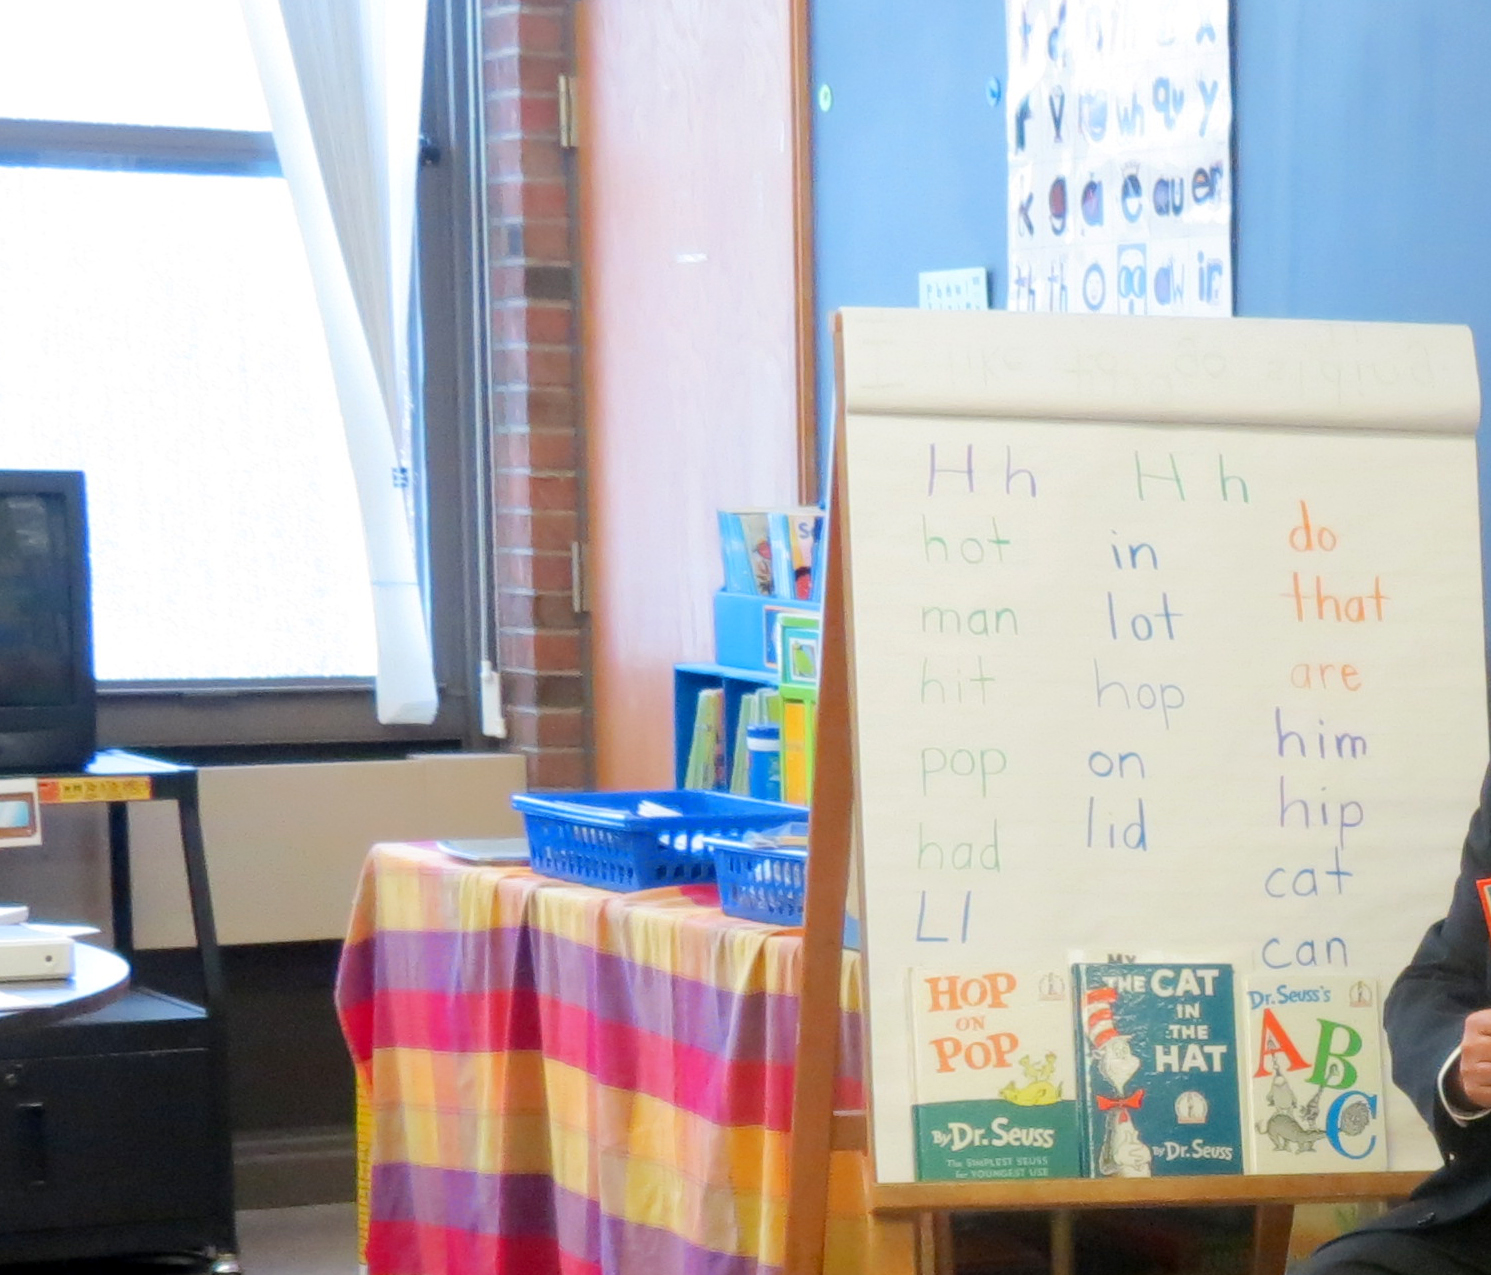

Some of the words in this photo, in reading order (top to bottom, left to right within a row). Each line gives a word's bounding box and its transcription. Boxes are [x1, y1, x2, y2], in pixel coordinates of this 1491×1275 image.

[922, 514, 1011, 563] hot
[1289, 500, 1338, 552] do
[1111, 530, 1158, 570] in
[1107, 592, 1183, 640] lot
[1281, 571, 1392, 622] that
[921, 606, 1018, 636] man
[921, 656, 996, 705] hit
[1094, 658, 1185, 730] hop
[1290, 661, 1363, 692] are
[1275, 707, 1367, 760] him
[921, 746, 1007, 798] pop
[1088, 750, 1145, 779] on
[1087, 796, 1147, 852] lid
[1279, 776, 1364, 850] hip
[916, 818, 1001, 873] had
[1264, 847, 1353, 898] cat
[1262, 935, 1349, 970] can
[924, 972, 1017, 1012] HOP
[1101, 974, 1146, 993] THE
[1150, 968, 1220, 997] CAT
[1247, 990, 1276, 1010] Dr.
[1276, 984, 1331, 1004] Seuss's
[956, 1016, 986, 1031] ON
[1176, 1002, 1200, 1018] IN
[1168, 1024, 1209, 1040] THE
[928, 1032, 1020, 1073] POP
[1155, 1043, 1227, 1072] HAT
[931, 1129, 950, 1148] By
[948, 1121, 987, 1150] Dr.
[990, 1117, 1055, 1149] Seuss
[1152, 1145, 1165, 1158] By
[1164, 1141, 1190, 1161] Dr.
[1191, 1139, 1233, 1161] Seuss
